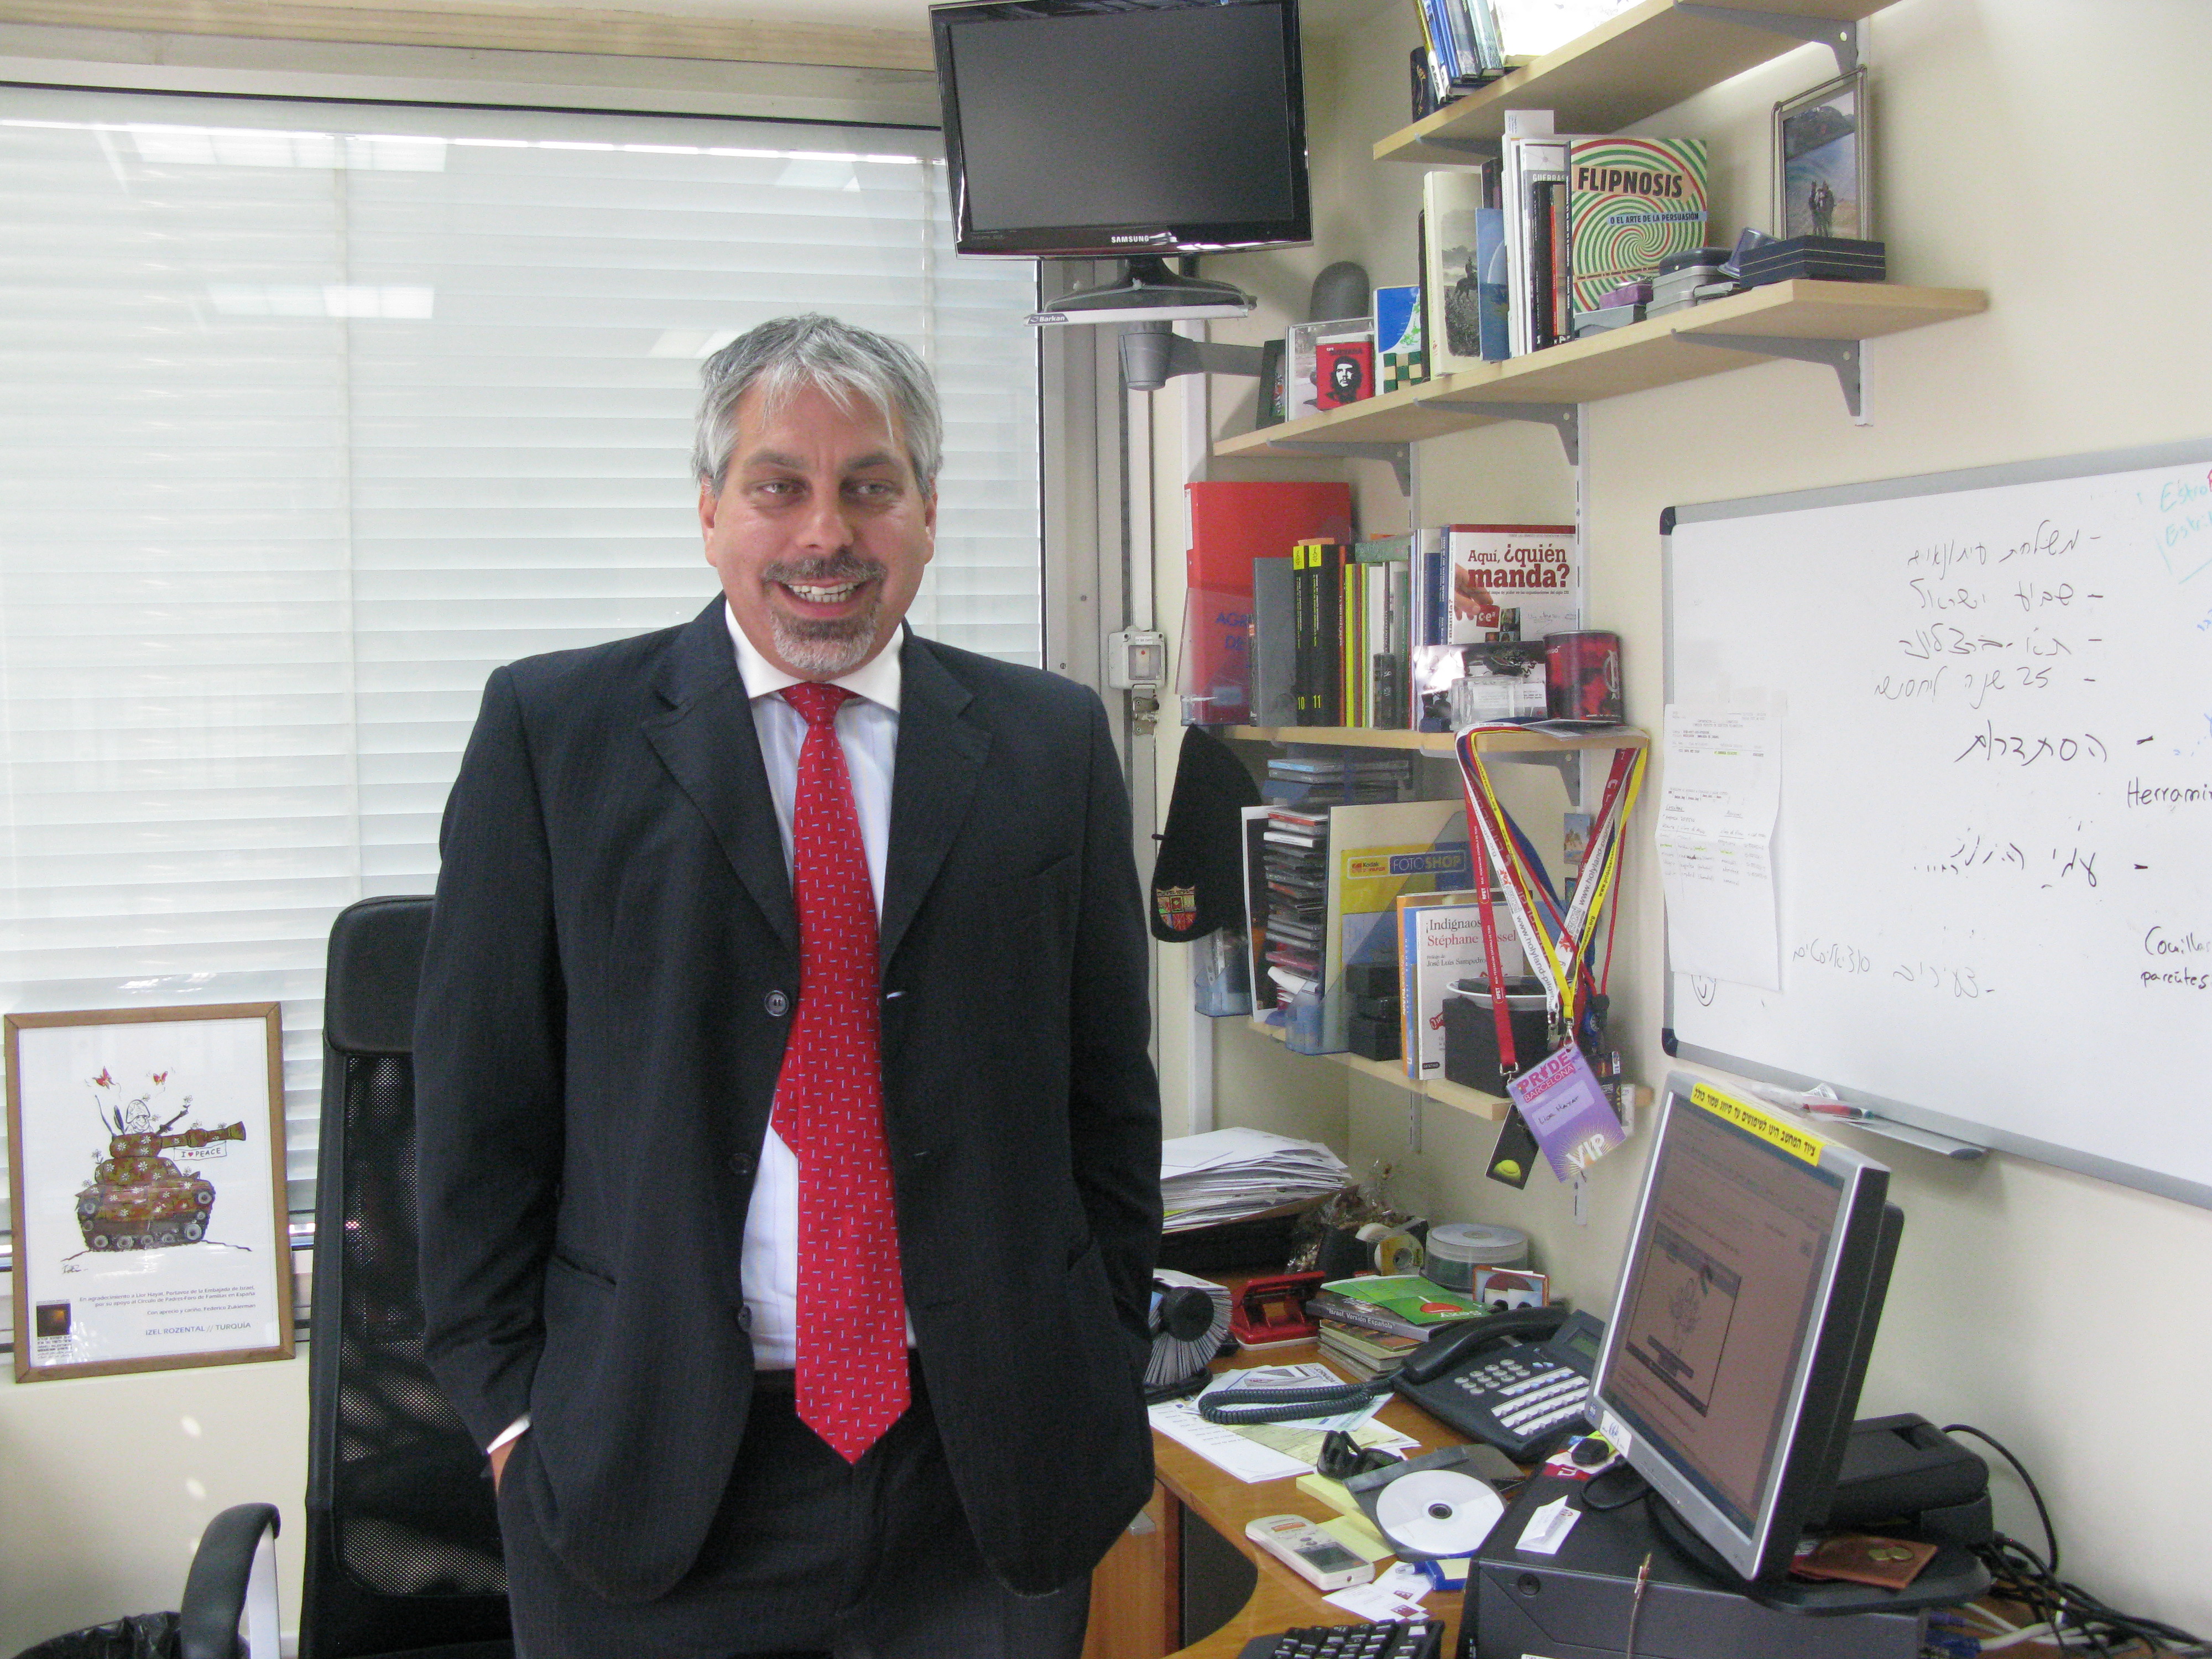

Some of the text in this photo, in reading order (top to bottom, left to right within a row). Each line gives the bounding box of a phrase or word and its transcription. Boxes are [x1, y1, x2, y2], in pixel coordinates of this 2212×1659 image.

[1578, 167, 1682, 198] FLIPNOSIS
[1625, 215, 1641, 223] ARTE
[1661, 212, 1699, 221] PERSUASIÓN
[1111, 235, 1150, 243] SAMSUNG
[1039, 314, 1066, 324] Barkan
[1468, 544, 1567, 567] Aquí, ¿quién
[1468, 563, 1570, 588] manda?
[2017, 666, 2052, 688] 25
[1297, 697, 1306, 711] 10
[1313, 695, 1321, 709] 11
[1427, 933, 1479, 948] Stéphane
[1455, 957, 1486, 966] Sampedro
[1516, 1053, 1573, 1094] PRIDE
[1524, 1063, 1575, 1103] BARCELONA
[1780, 1131, 1802, 1149] המחשב
[195, 1147, 221, 1157] PEACE
[1566, 1133, 1606, 1168] VIP
[1803, 1141, 1816, 1157] ציוד
[1345, 1311, 1366, 1323] Versión
[164, 1325, 205, 1334] ROZENTAL
[216, 1321, 251, 1331] TURQUÍA
